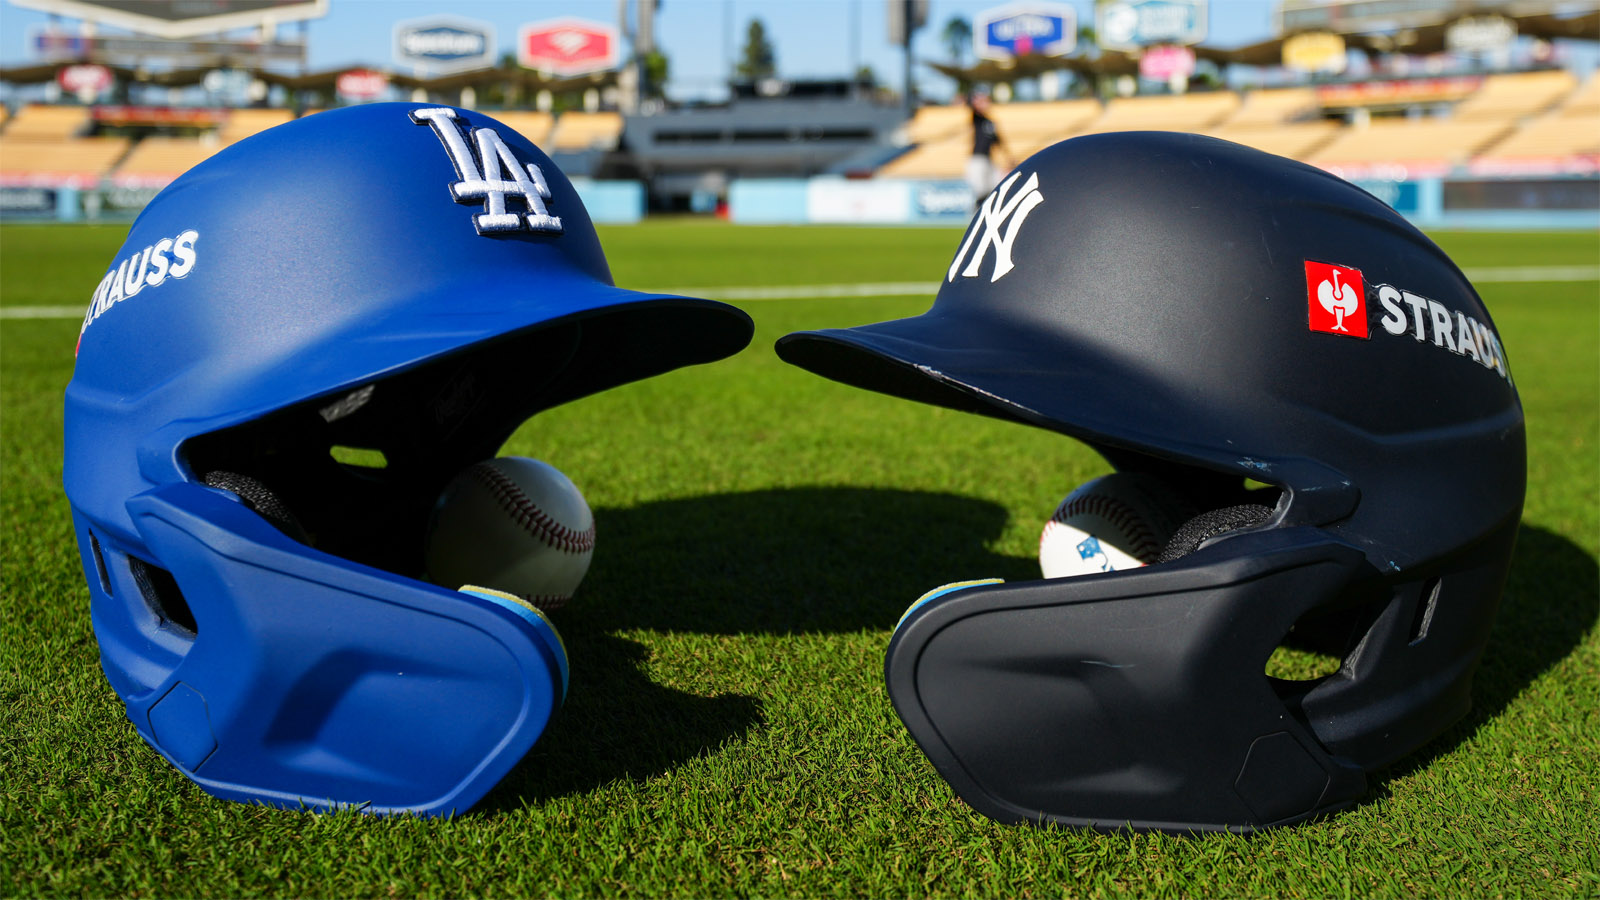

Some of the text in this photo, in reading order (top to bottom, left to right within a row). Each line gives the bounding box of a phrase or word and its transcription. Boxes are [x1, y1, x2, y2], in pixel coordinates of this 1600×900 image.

[409, 107, 563, 234] LA
[948, 171, 1044, 283] NY
[81, 229, 199, 334] TRAUSS
[1378, 284, 1512, 386] STRAUS
